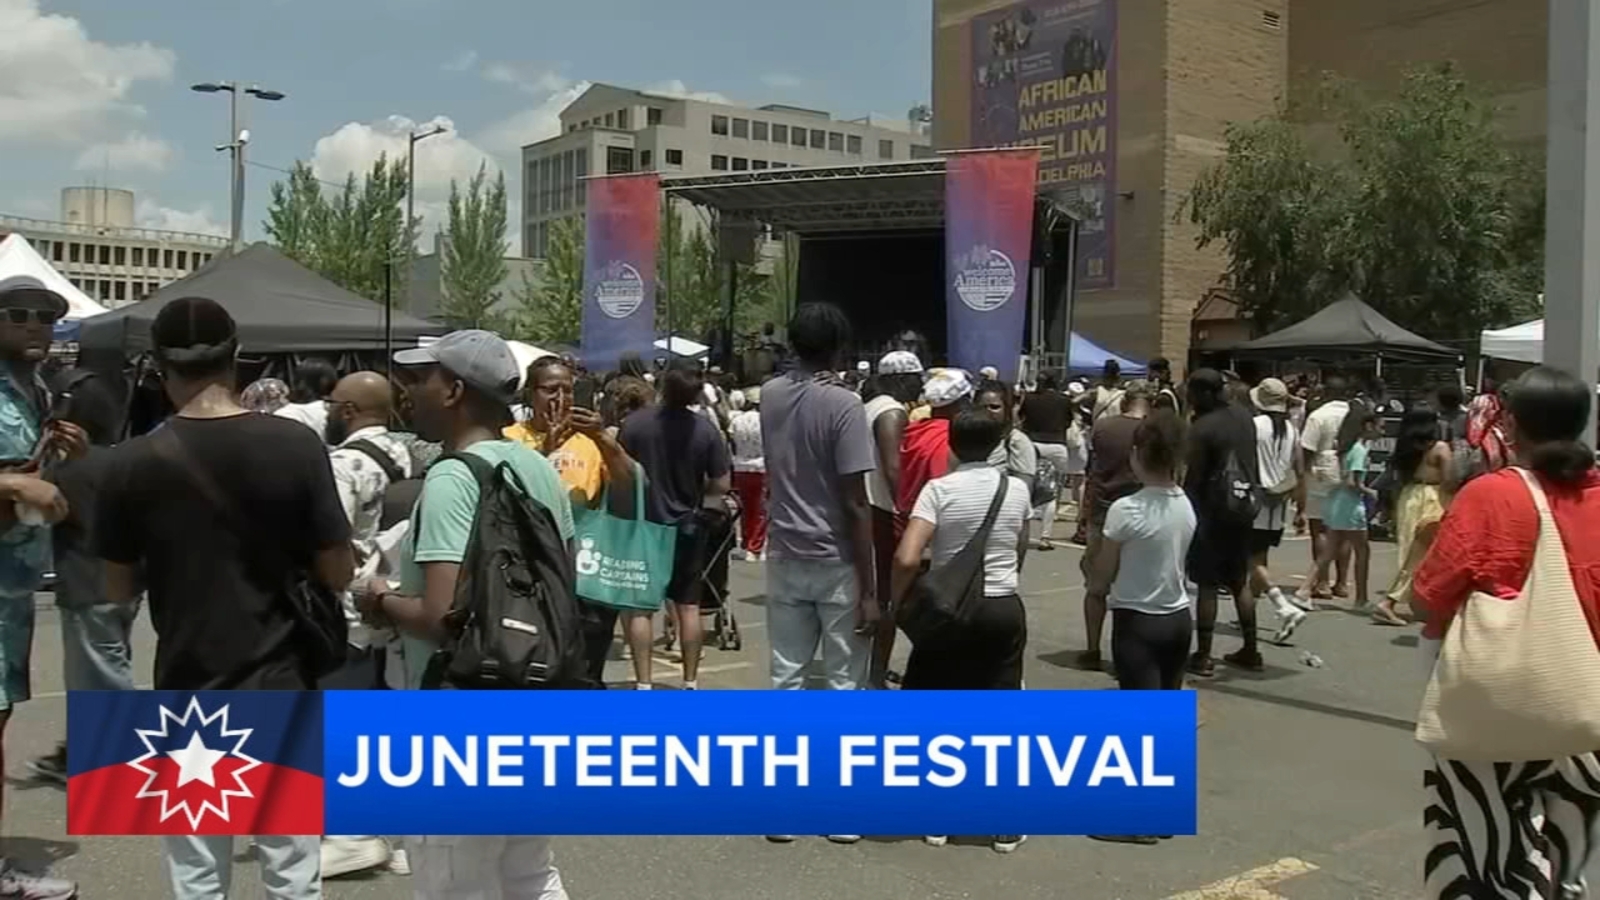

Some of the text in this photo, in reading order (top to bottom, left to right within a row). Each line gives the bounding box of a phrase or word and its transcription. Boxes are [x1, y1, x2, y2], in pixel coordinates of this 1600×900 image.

[1018, 69, 1107, 109] AFRICAN
[1018, 99, 1107, 132] AMERICAN
[1038, 161, 1106, 184] DELPHIA
